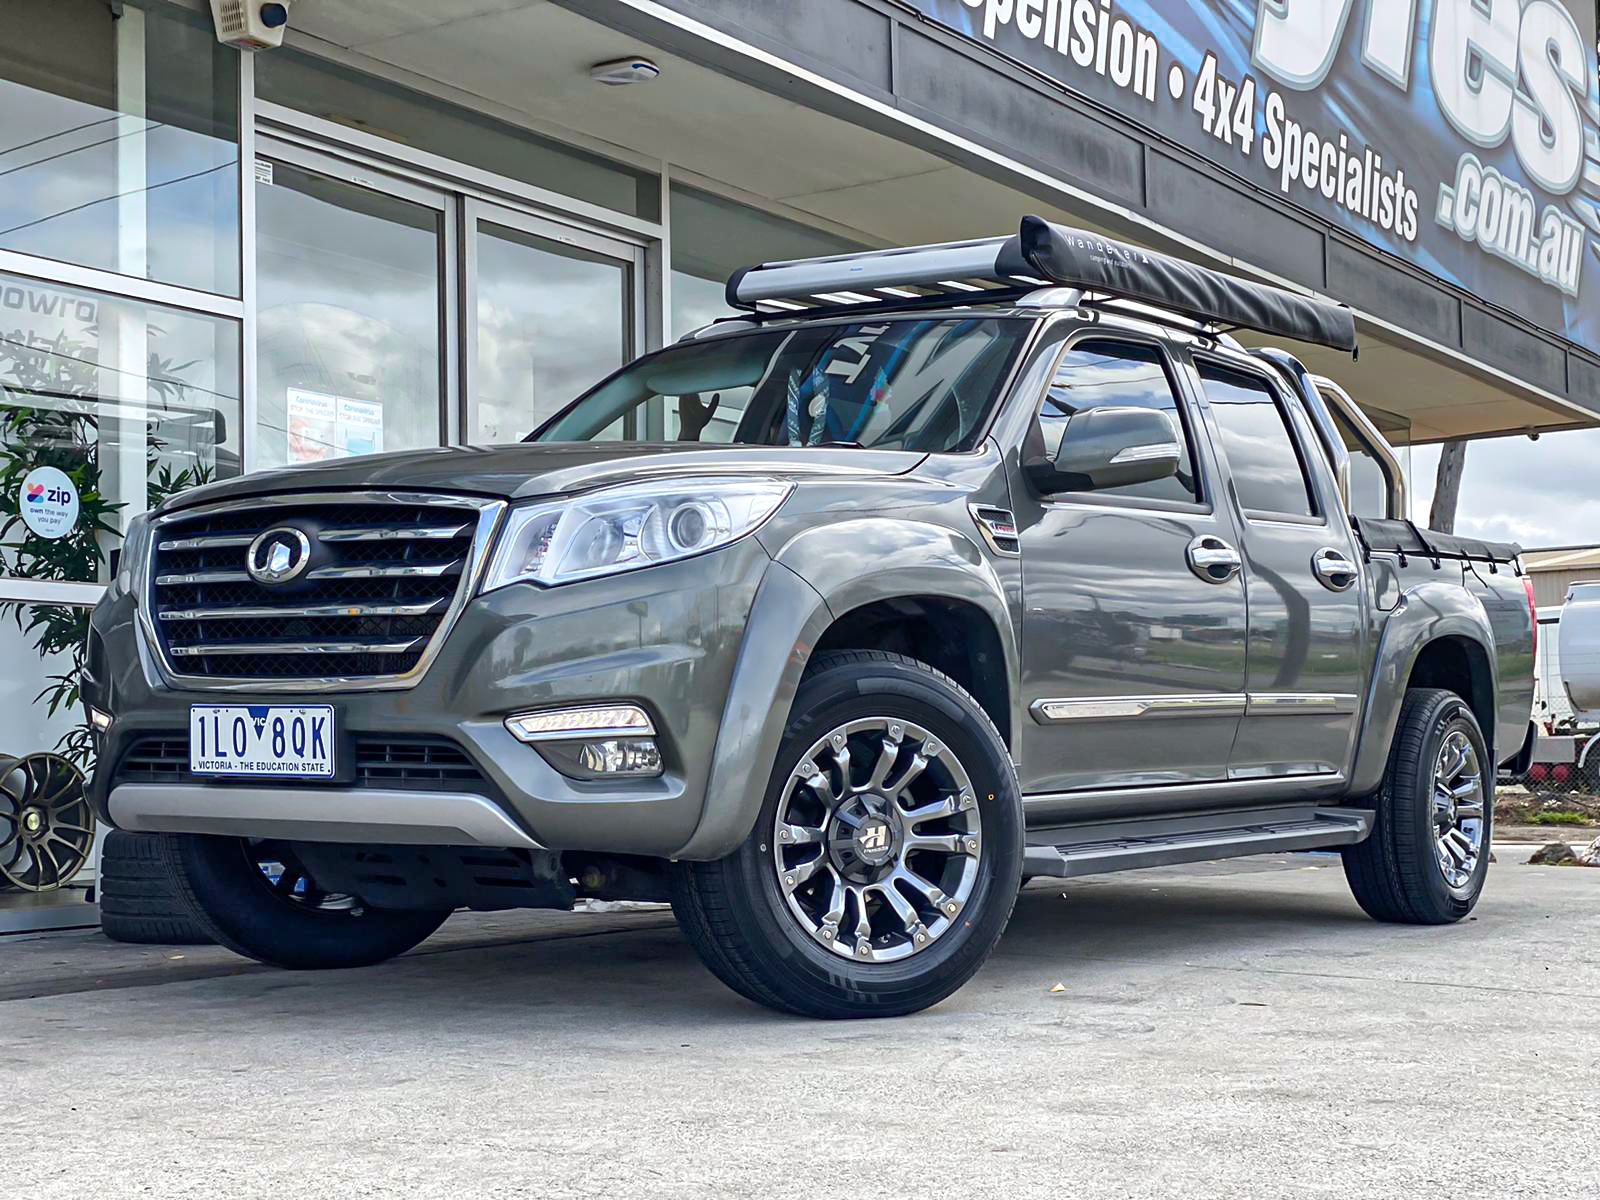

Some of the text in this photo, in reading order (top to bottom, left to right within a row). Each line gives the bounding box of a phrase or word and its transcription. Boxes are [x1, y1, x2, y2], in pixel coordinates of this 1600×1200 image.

[1193, 54, 1256, 155] 4x4
[1263, 92, 1418, 241] Specialists
[1437, 160, 1582, 292] .com.au
[45, 508, 55, 516] the
[47, 486, 71, 506] zip
[272, 716, 326, 760] 8QK
[198, 760, 233, 770] VICTORIA
[240, 761, 255, 771] THE
[256, 762, 300, 772] EDUCATION
[301, 762, 325, 772] STATE
